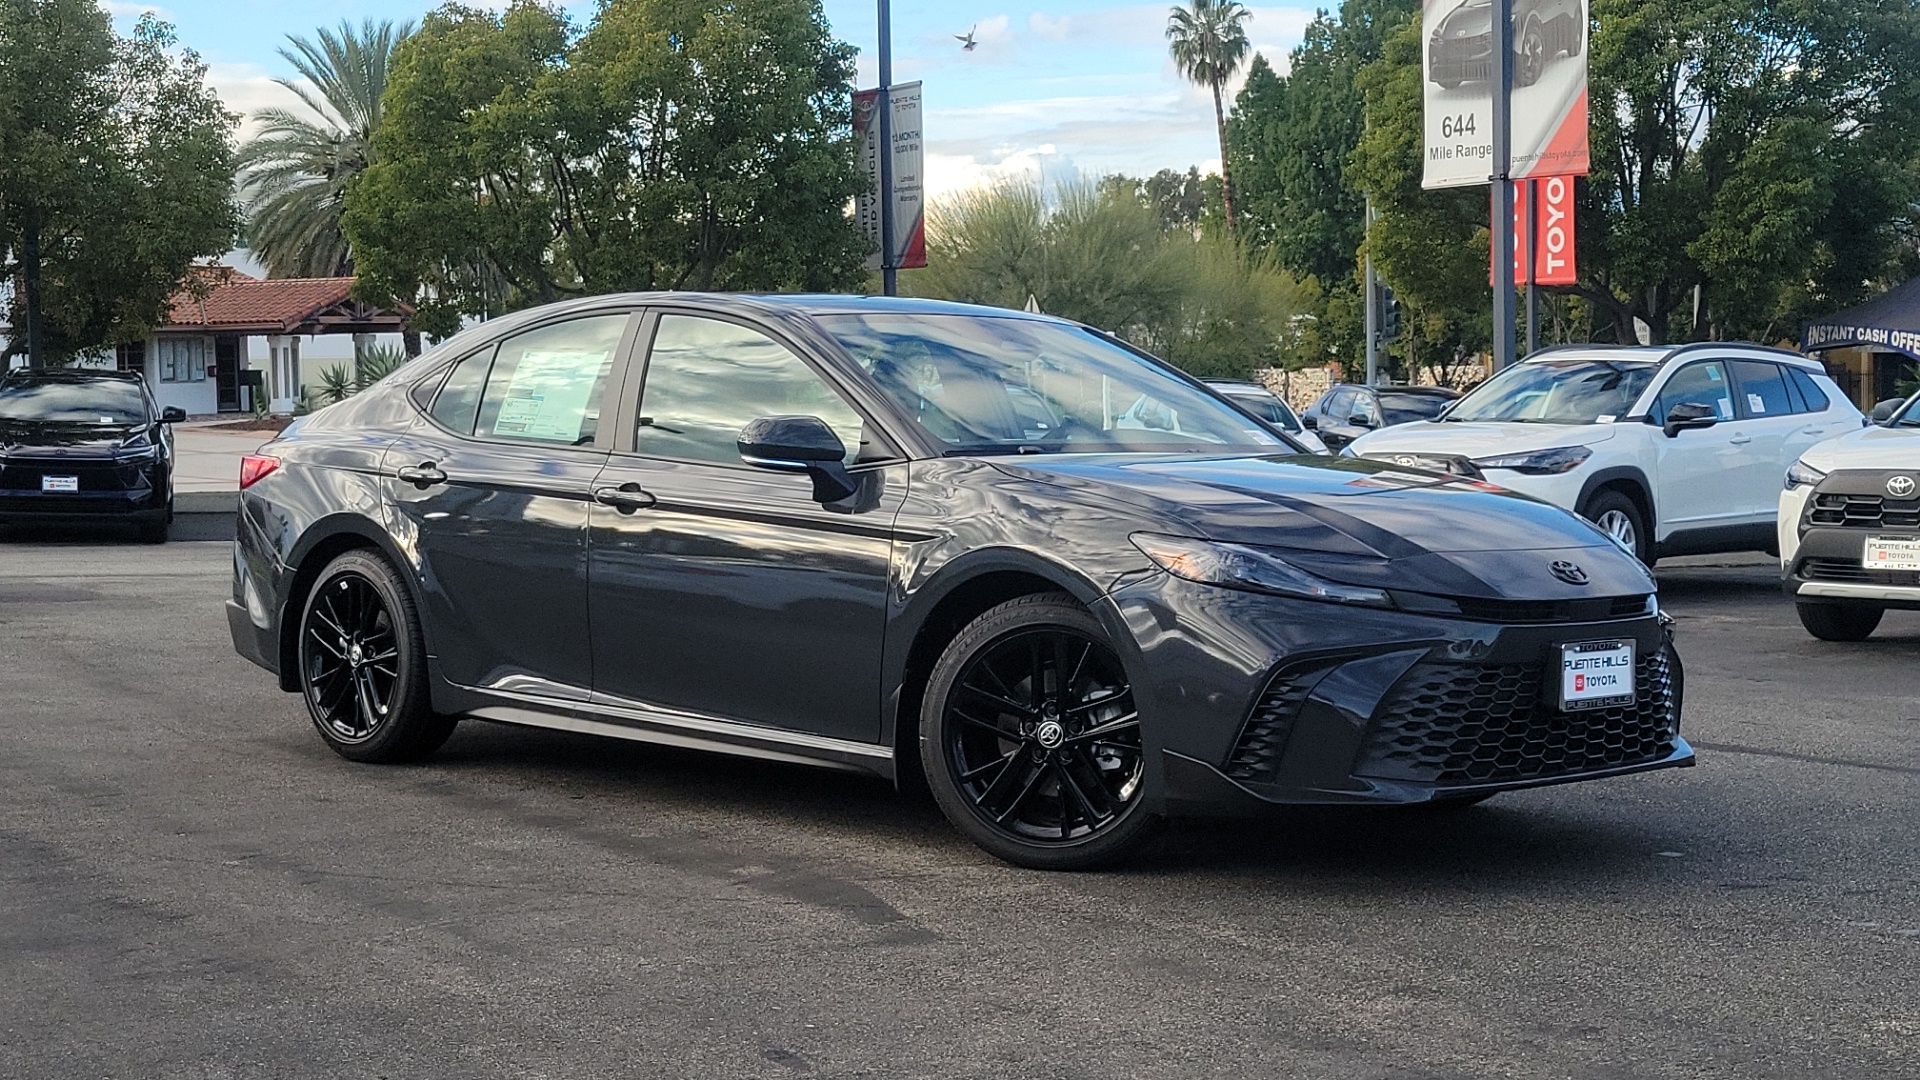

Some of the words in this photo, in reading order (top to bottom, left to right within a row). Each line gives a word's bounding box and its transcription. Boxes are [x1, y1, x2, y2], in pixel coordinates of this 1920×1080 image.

[1442, 112, 1476, 138] 644
[1430, 146, 1452, 161] Mile
[1456, 144, 1492, 159] Range
[1807, 325, 1855, 346] INSTANT
[1856, 327, 1888, 344] CASH
[1580, 641, 1618, 651] TOYOTA
[1564, 658, 1600, 671] PUENTE
[1602, 656, 1629, 668] HILLS
[1586, 674, 1617, 688] TOYOTA
